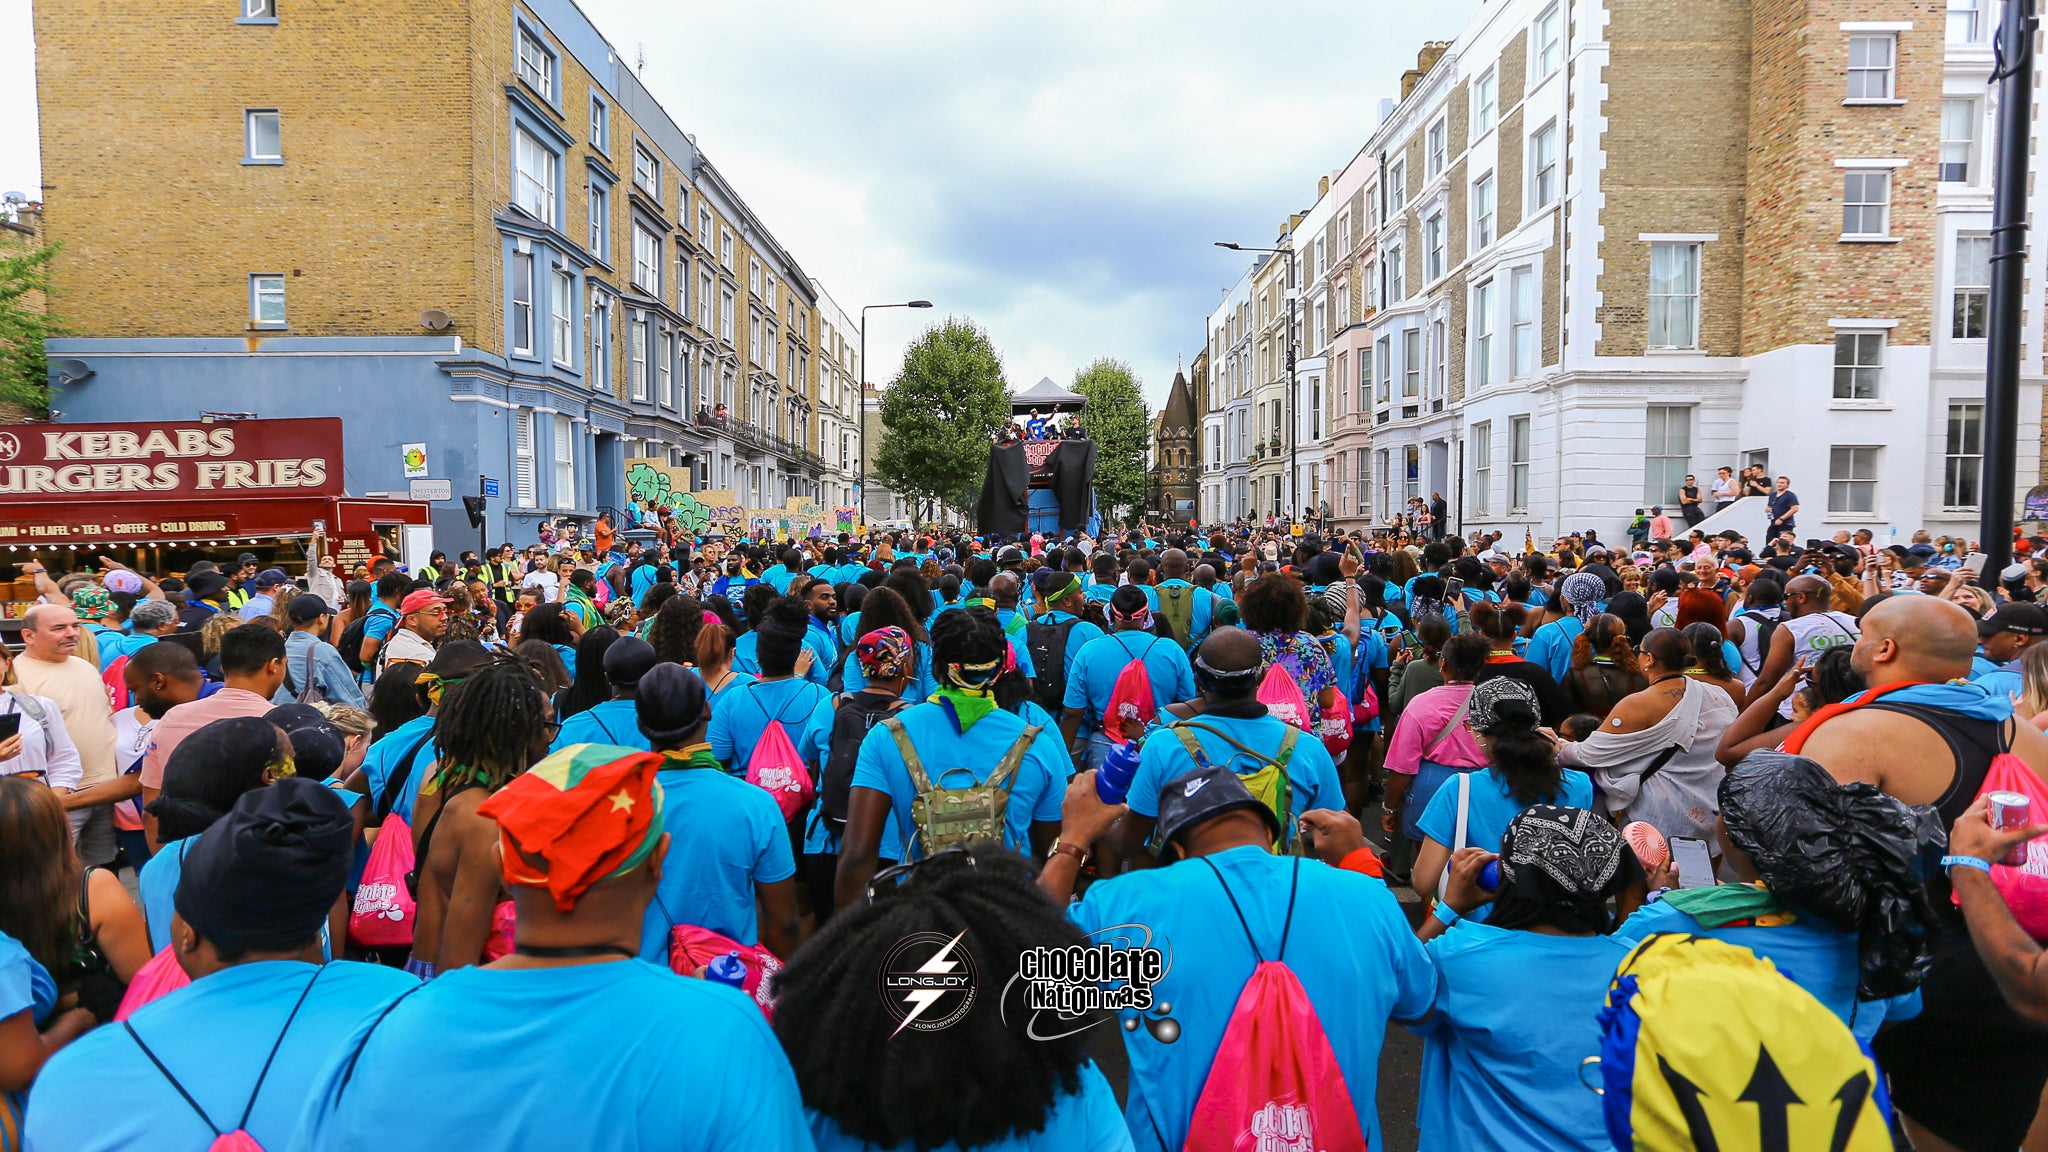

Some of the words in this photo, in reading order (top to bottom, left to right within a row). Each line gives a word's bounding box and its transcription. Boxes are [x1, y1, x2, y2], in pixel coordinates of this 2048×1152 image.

[42, 428, 235, 460] KEBABS
[195, 458, 327, 490] FRIES
[29, 525, 71, 536] FALAFEL
[81, 524, 102, 535] TEA
[113, 523, 149, 534] COFFEE
[160, 521, 186, 533] COLD
[188, 520, 226, 532] DRINKS
